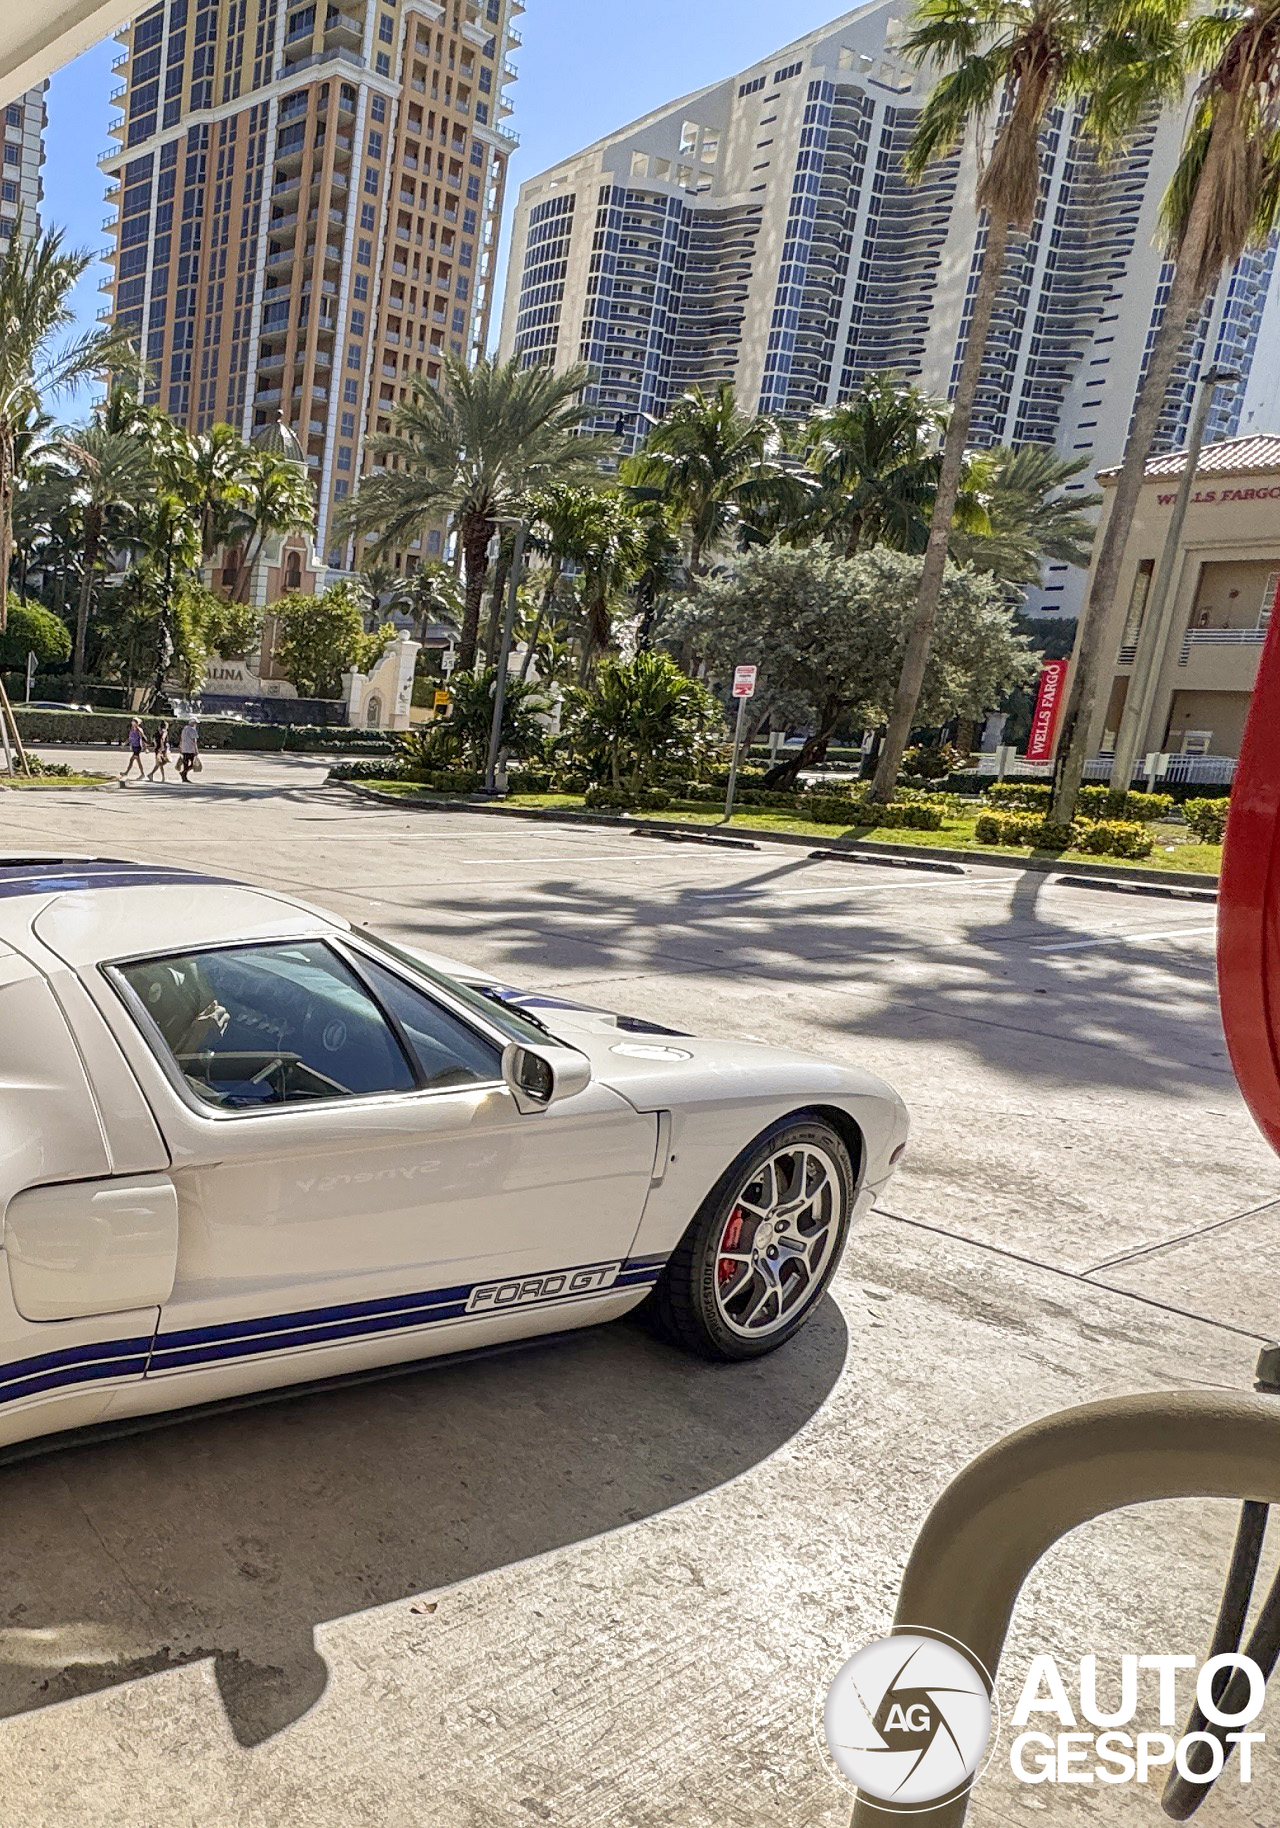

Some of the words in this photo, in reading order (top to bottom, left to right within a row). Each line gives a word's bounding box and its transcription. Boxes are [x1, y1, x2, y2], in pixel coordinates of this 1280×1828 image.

[1157, 491, 1216, 506] WLS
[206, 668, 243, 681] ALINA
[1041, 664, 1060, 708] FARGO
[1032, 710, 1051, 754] WELLS
[470, 1275, 567, 1308] FORD
[569, 1266, 617, 1290] GT
